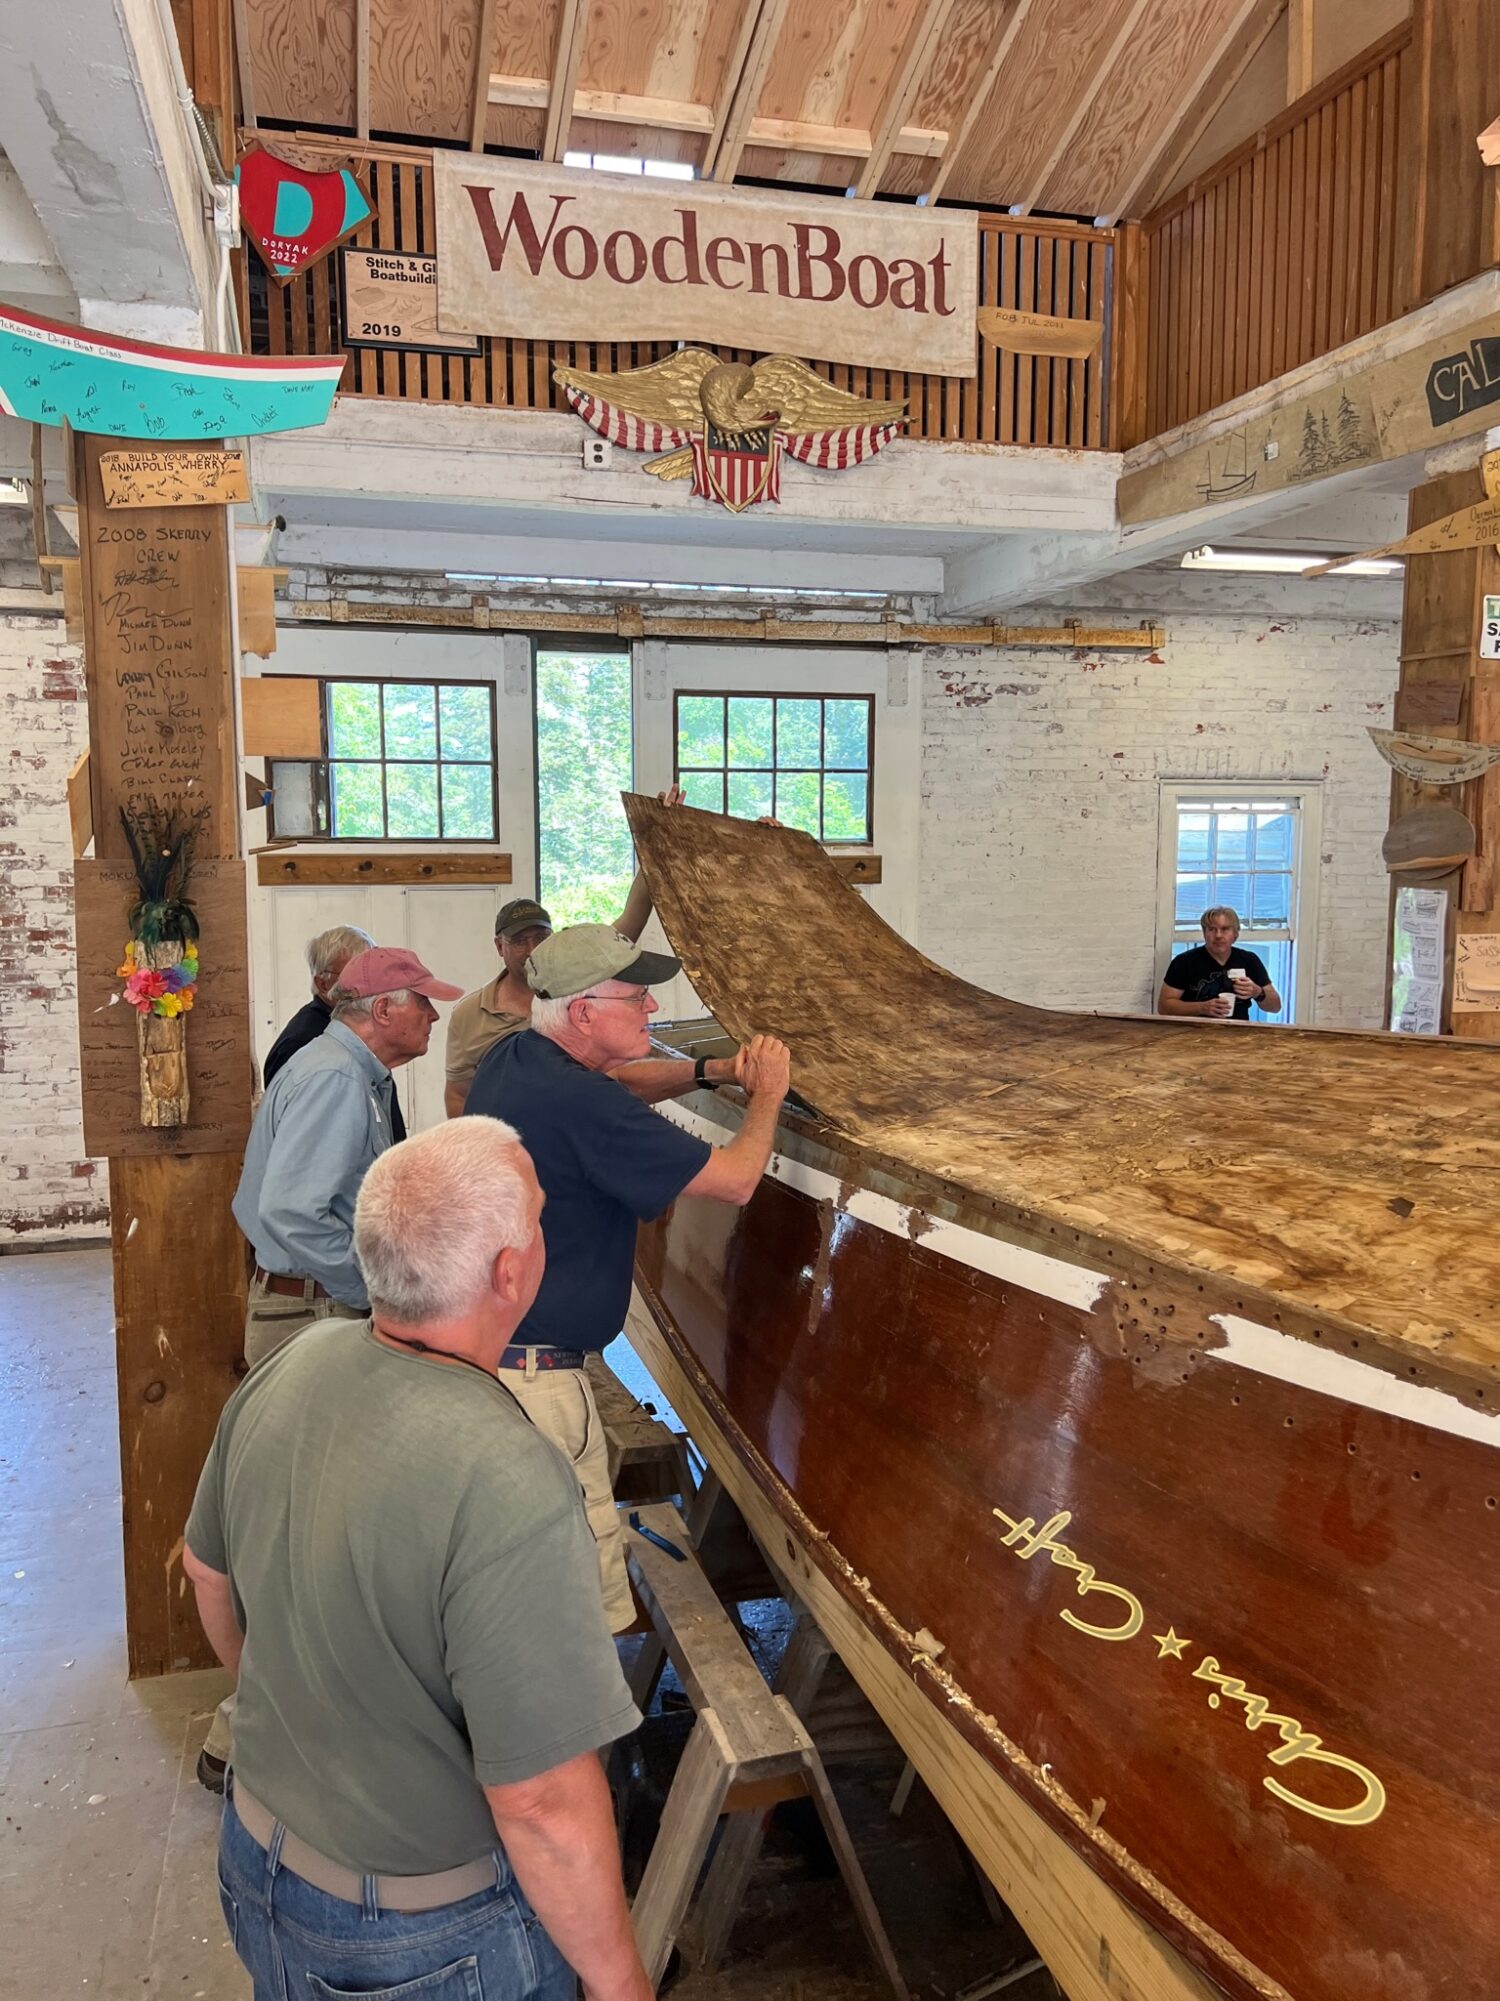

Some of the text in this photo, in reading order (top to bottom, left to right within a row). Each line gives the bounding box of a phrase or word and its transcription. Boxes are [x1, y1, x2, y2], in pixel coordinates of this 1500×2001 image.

[273, 181, 314, 237] D
[262, 238, 309, 255] DORYAK
[461, 184, 956, 317] WoodenBoat
[270, 250, 298, 263] 2022
[366, 256, 436, 273] Stitch & Gl
[370, 268, 436, 284] Boatbuildi
[362, 322, 402, 337] 2019
[48, 332, 72, 346] Drift
[73, 339, 94, 353] Boat
[98, 347, 123, 360] Class
[128, 453, 159, 463] BUILD
[161, 453, 189, 462] YOUR
[195, 453, 220, 462] OWN
[109, 459, 228, 474] ANNAPOLIS WHERRY
[97, 527, 212, 543] 2008 SKERRY
[1475, 523, 1500, 541] 2016
[136, 548, 181, 564] CREW
[991, 1510, 1387, 1826] Chris Craft
